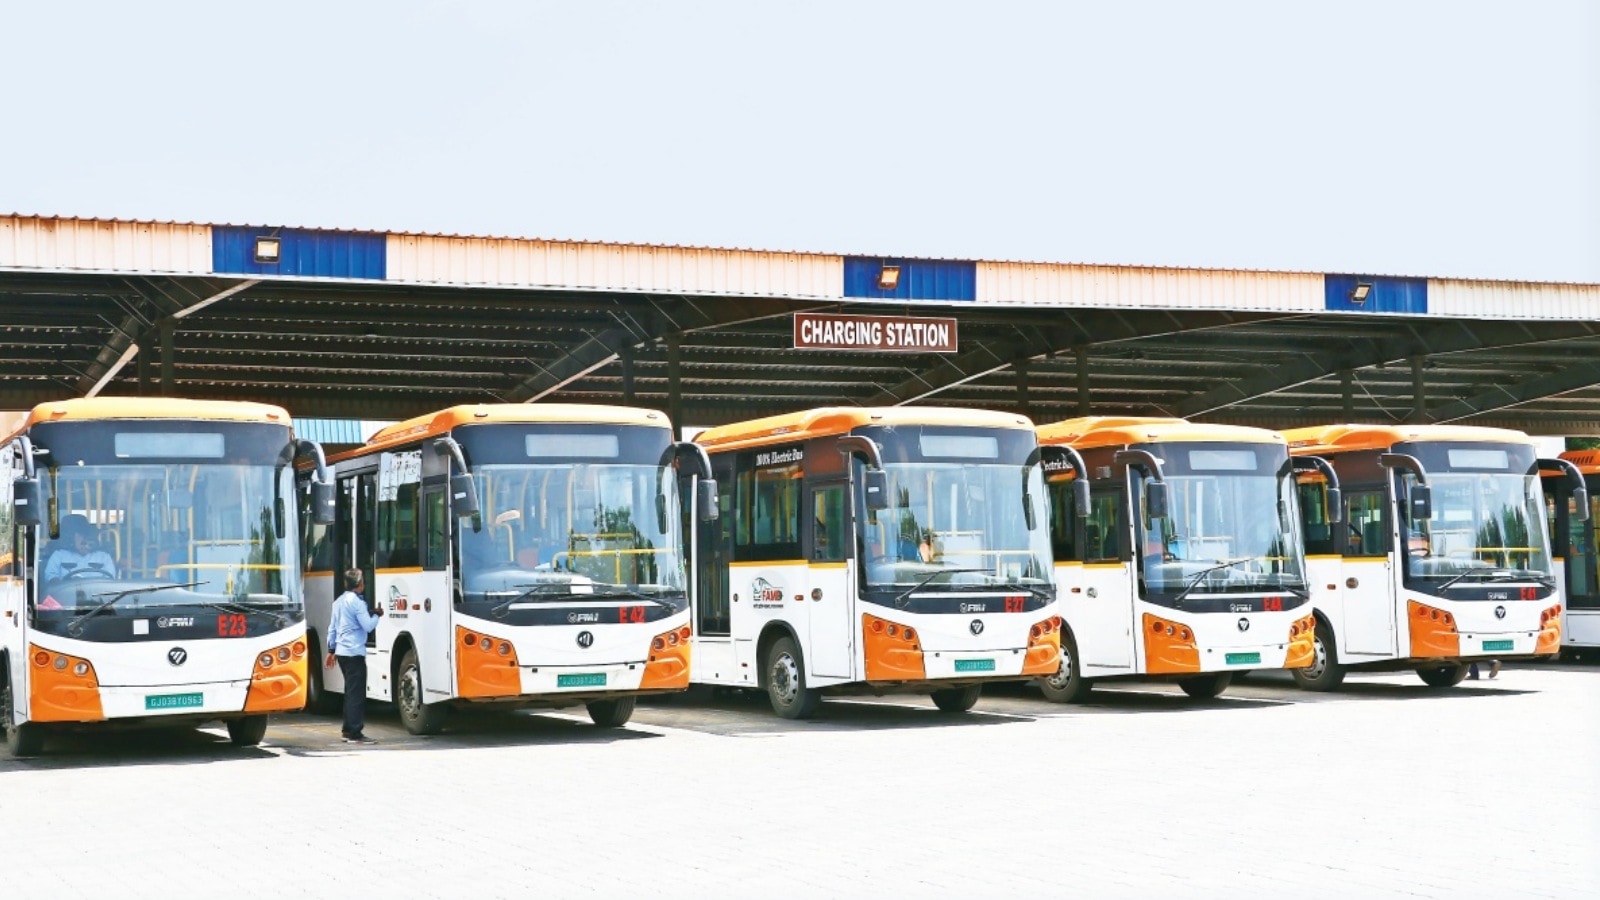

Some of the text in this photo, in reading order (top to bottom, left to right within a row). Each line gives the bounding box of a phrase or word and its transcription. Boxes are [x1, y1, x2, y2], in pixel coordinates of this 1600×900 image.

[801, 319, 949, 347] CHARGING STATION
[1005, 596, 1025, 613] E27
